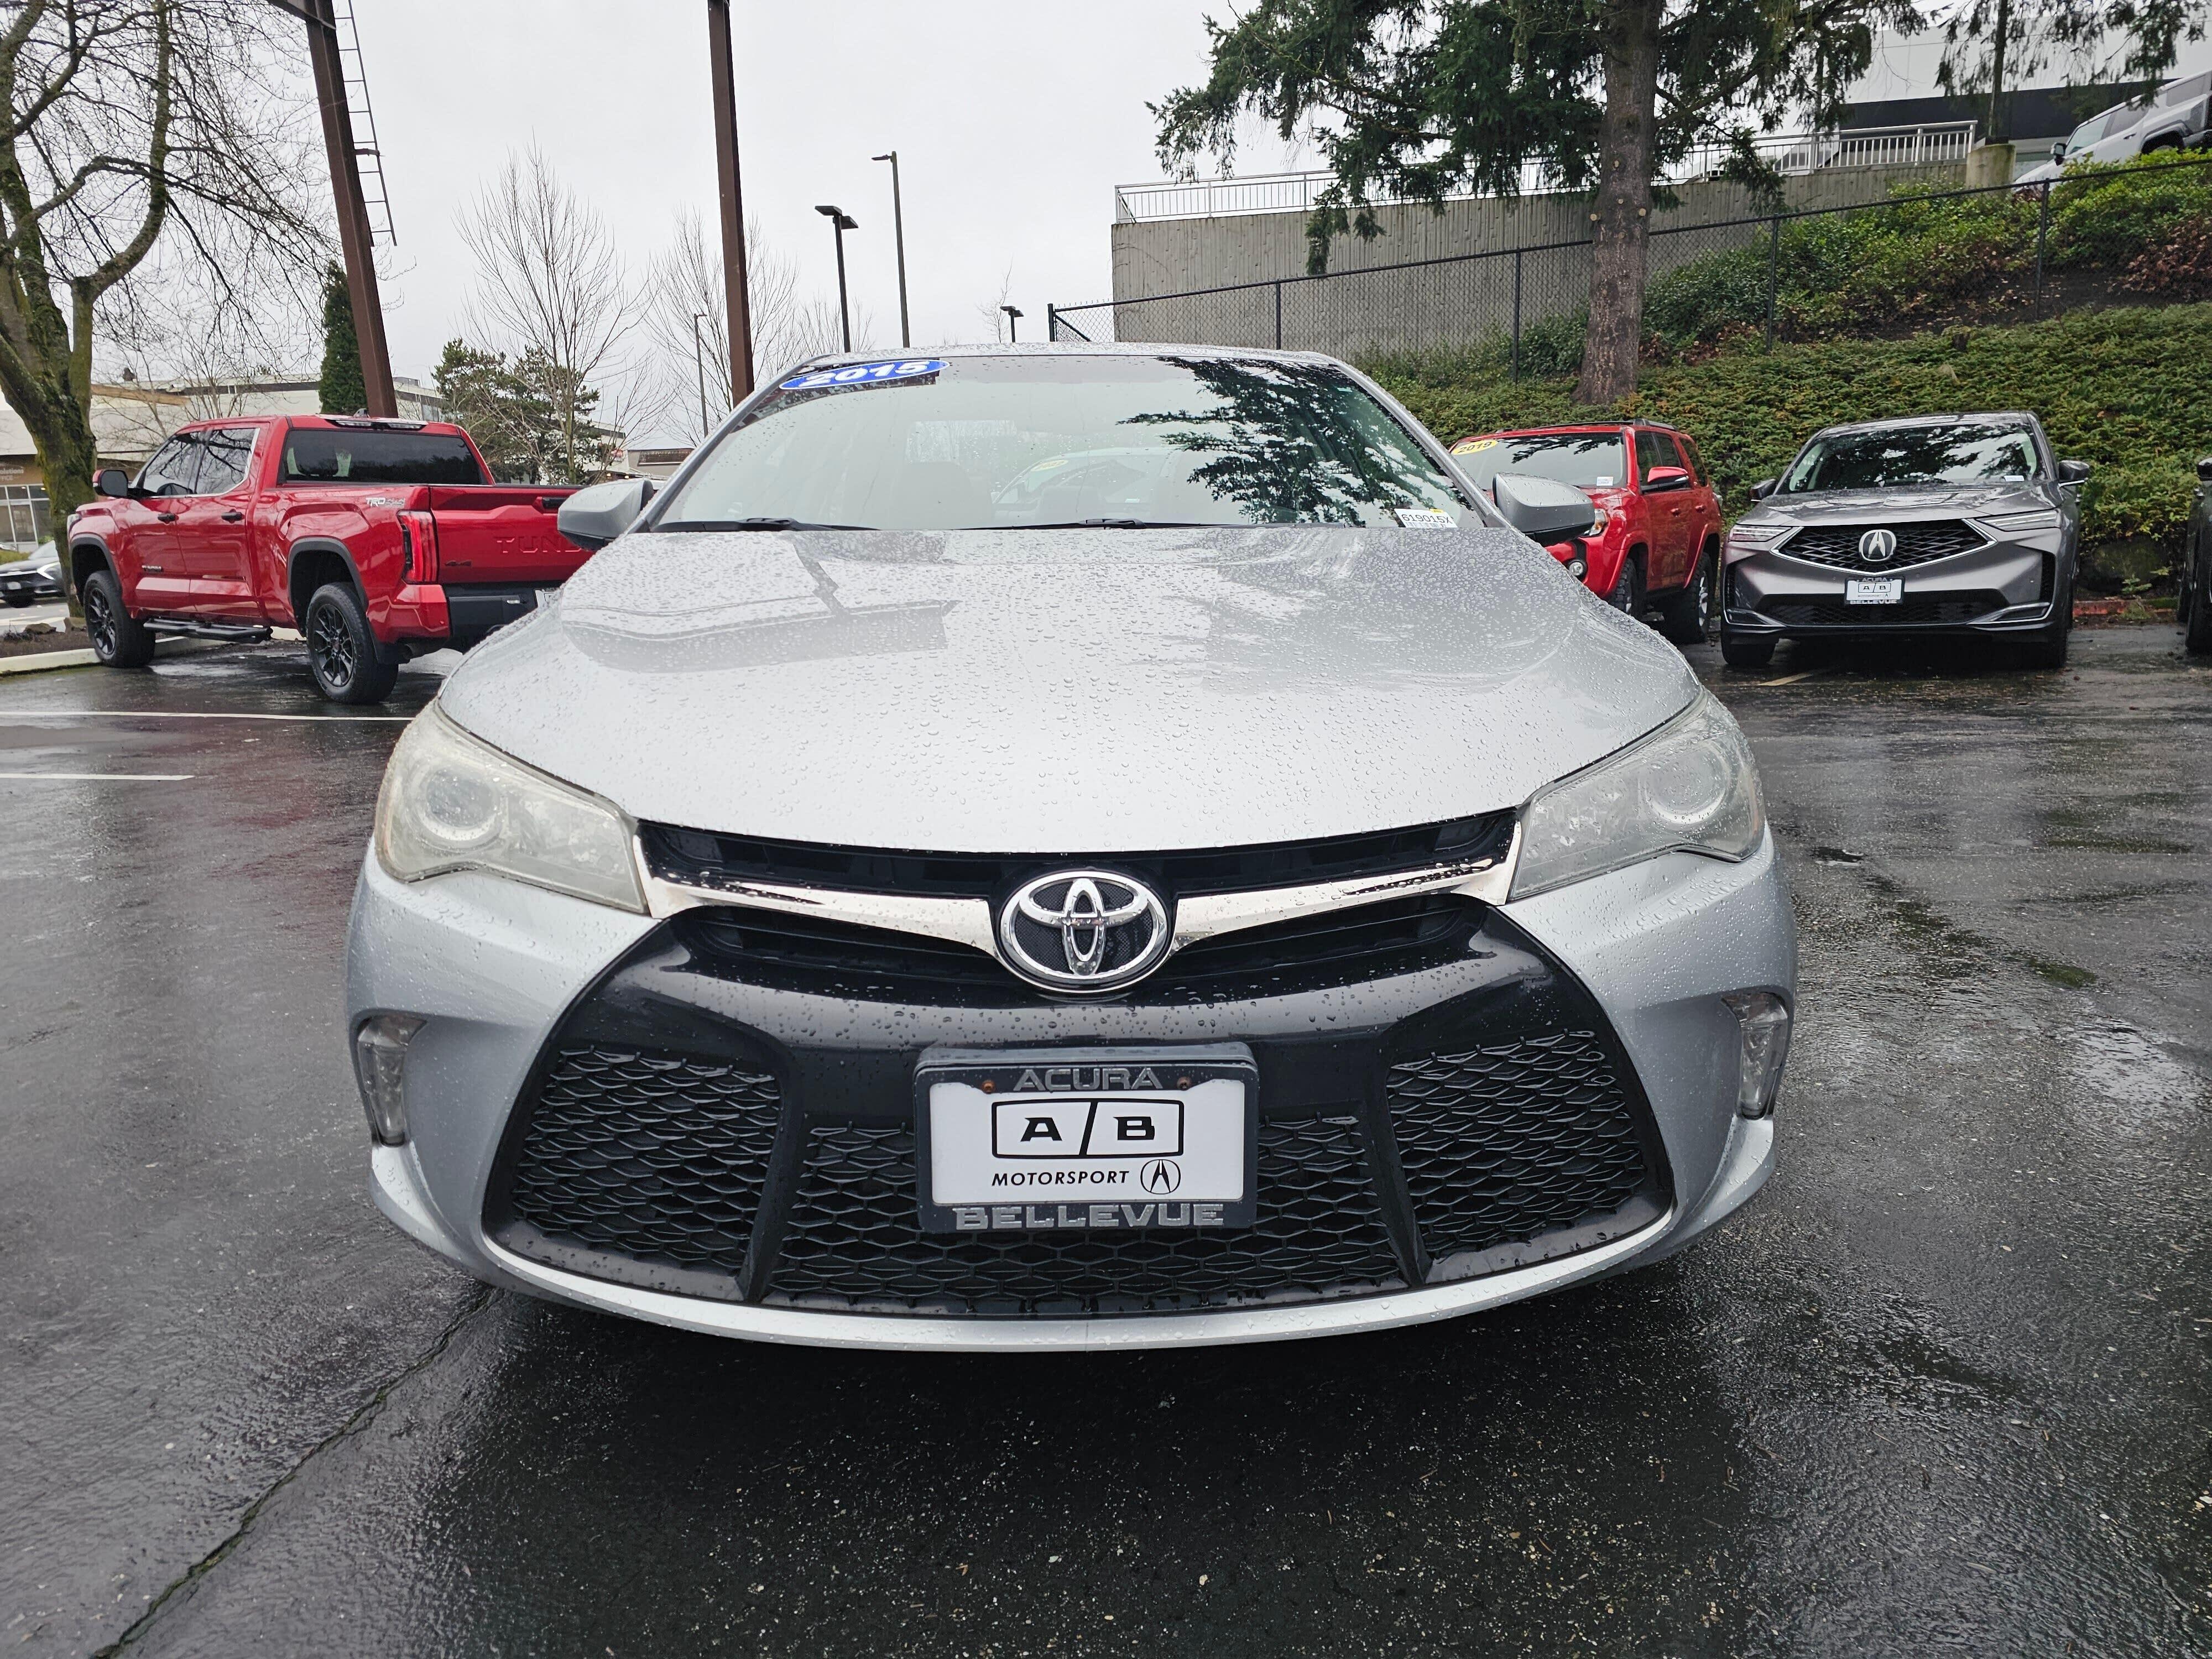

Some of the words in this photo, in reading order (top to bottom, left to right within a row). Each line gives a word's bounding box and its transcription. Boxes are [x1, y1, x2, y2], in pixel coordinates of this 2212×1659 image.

[799, 361, 930, 387] 2015
[1457, 441, 1493, 453] 2019
[366, 497, 385, 507] TRD
[1401, 514, 1453, 524] 619015X
[1013, 1067, 1163, 1092] ACURA
[992, 1170, 1130, 1186] MOTORSPORT
[952, 1203, 1224, 1230] BELLEVUE
